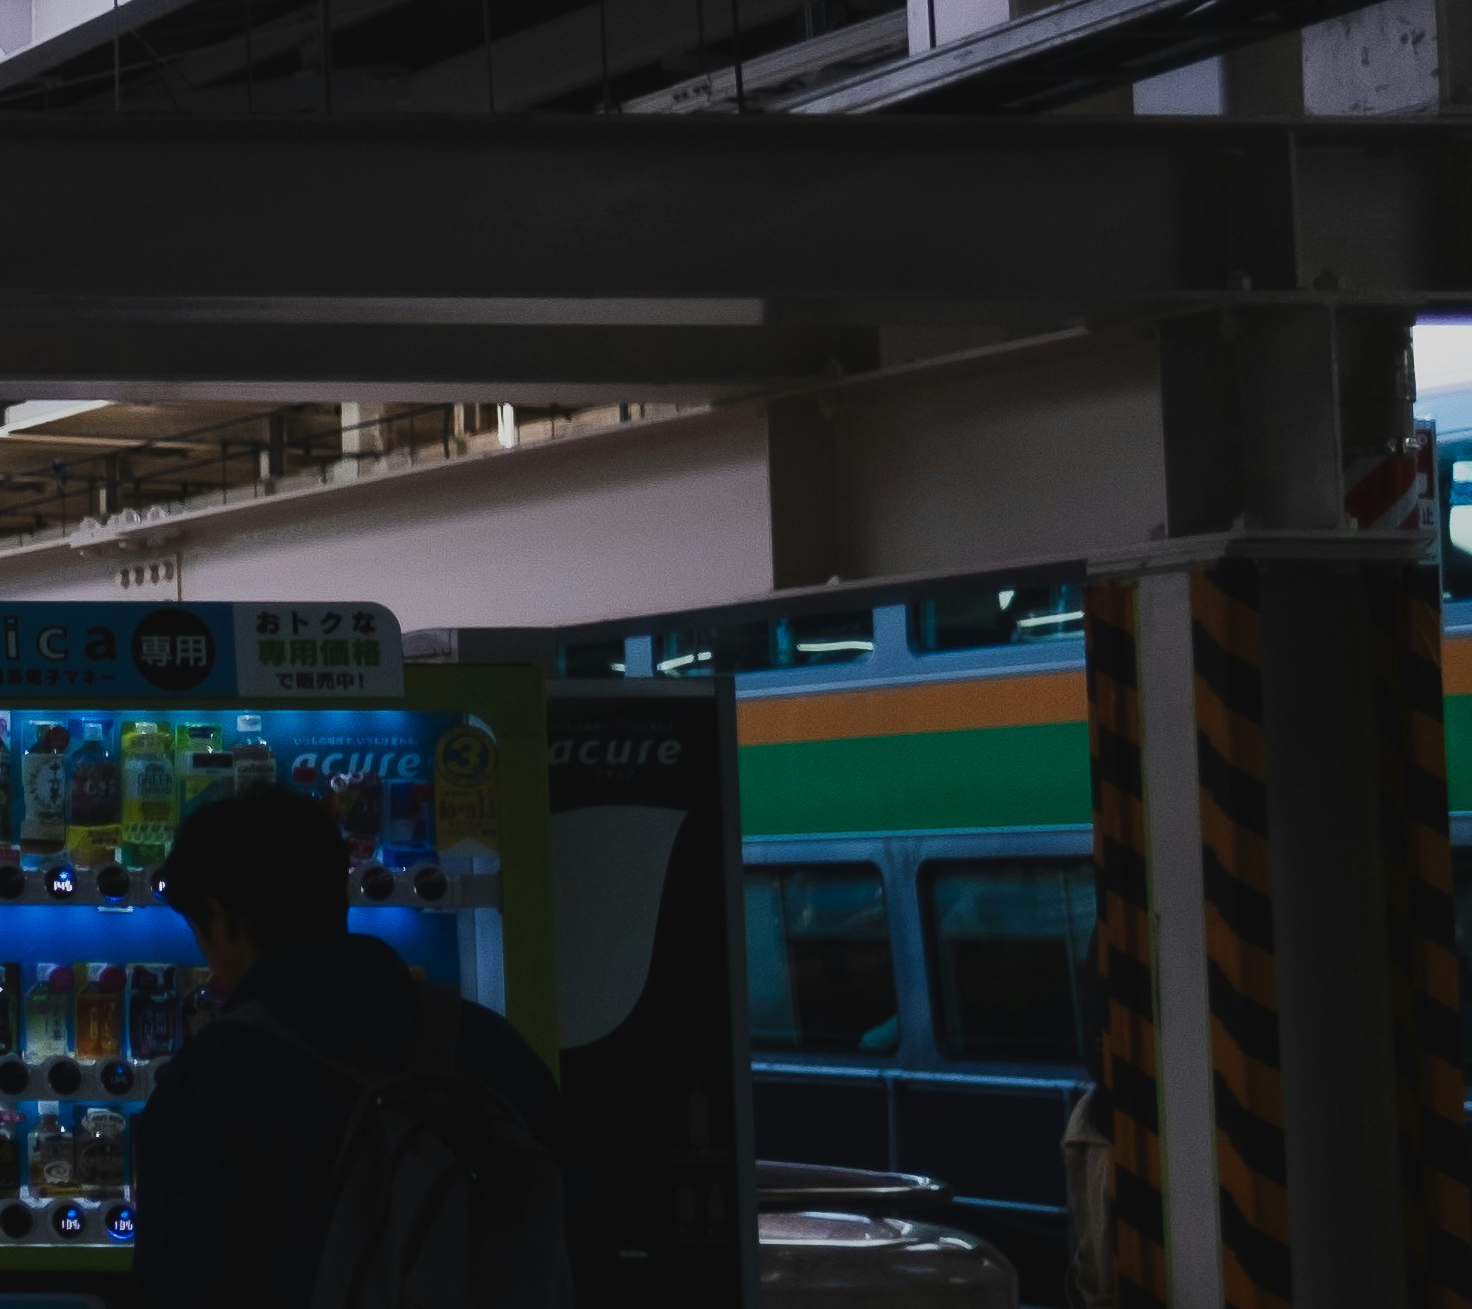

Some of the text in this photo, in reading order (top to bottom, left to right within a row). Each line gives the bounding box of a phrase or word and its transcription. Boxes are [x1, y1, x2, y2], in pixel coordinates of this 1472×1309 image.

[257, 609, 376, 635] おトクな
[140, 633, 207, 668] 専用
[257, 637, 380, 667] 専用価格
[292, 753, 422, 778] acure
[448, 737, 482, 775] 3
[548, 739, 683, 766] acure
